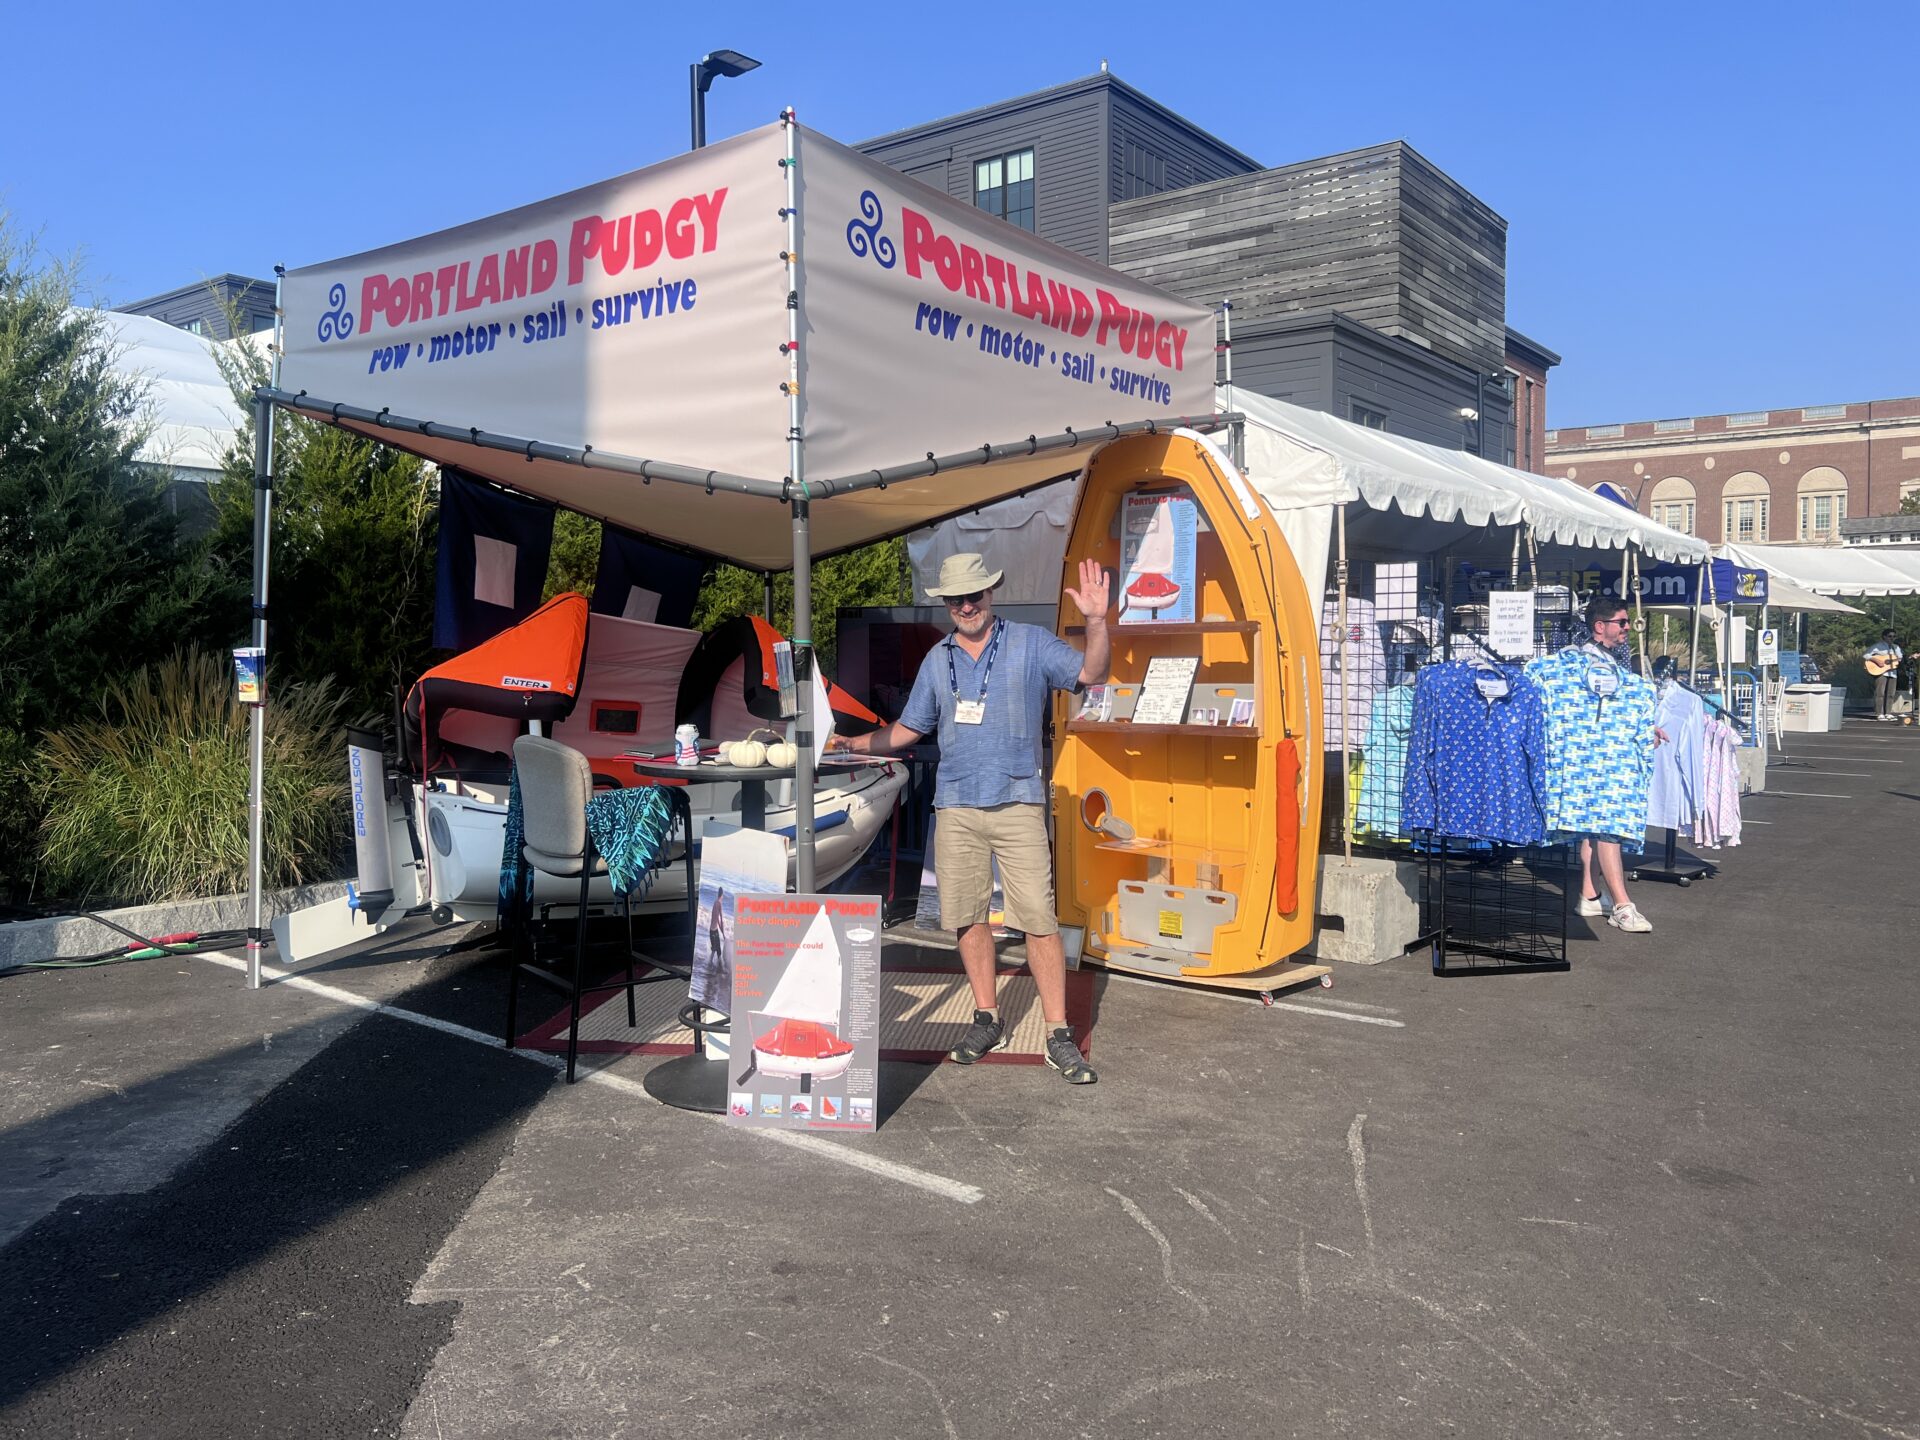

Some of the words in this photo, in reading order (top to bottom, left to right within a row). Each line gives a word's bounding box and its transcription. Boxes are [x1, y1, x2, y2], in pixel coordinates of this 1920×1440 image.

[359, 238, 558, 334] PORTLAND
[568, 187, 729, 285] PUDGY
[902, 207, 1095, 338] PORTLAND
[1096, 289, 1188, 371] PUDGY
[368, 341, 412, 374] row
[428, 321, 501, 364] motor
[522, 300, 566, 345] sail
[591, 277, 697, 330] survive
[915, 302, 962, 341] row
[980, 324, 1044, 368] motor
[1061, 351, 1094, 384] sail
[1110, 366, 1171, 406] survive
[504, 678, 540, 688] ENTER
[802, 942, 824, 950] could
